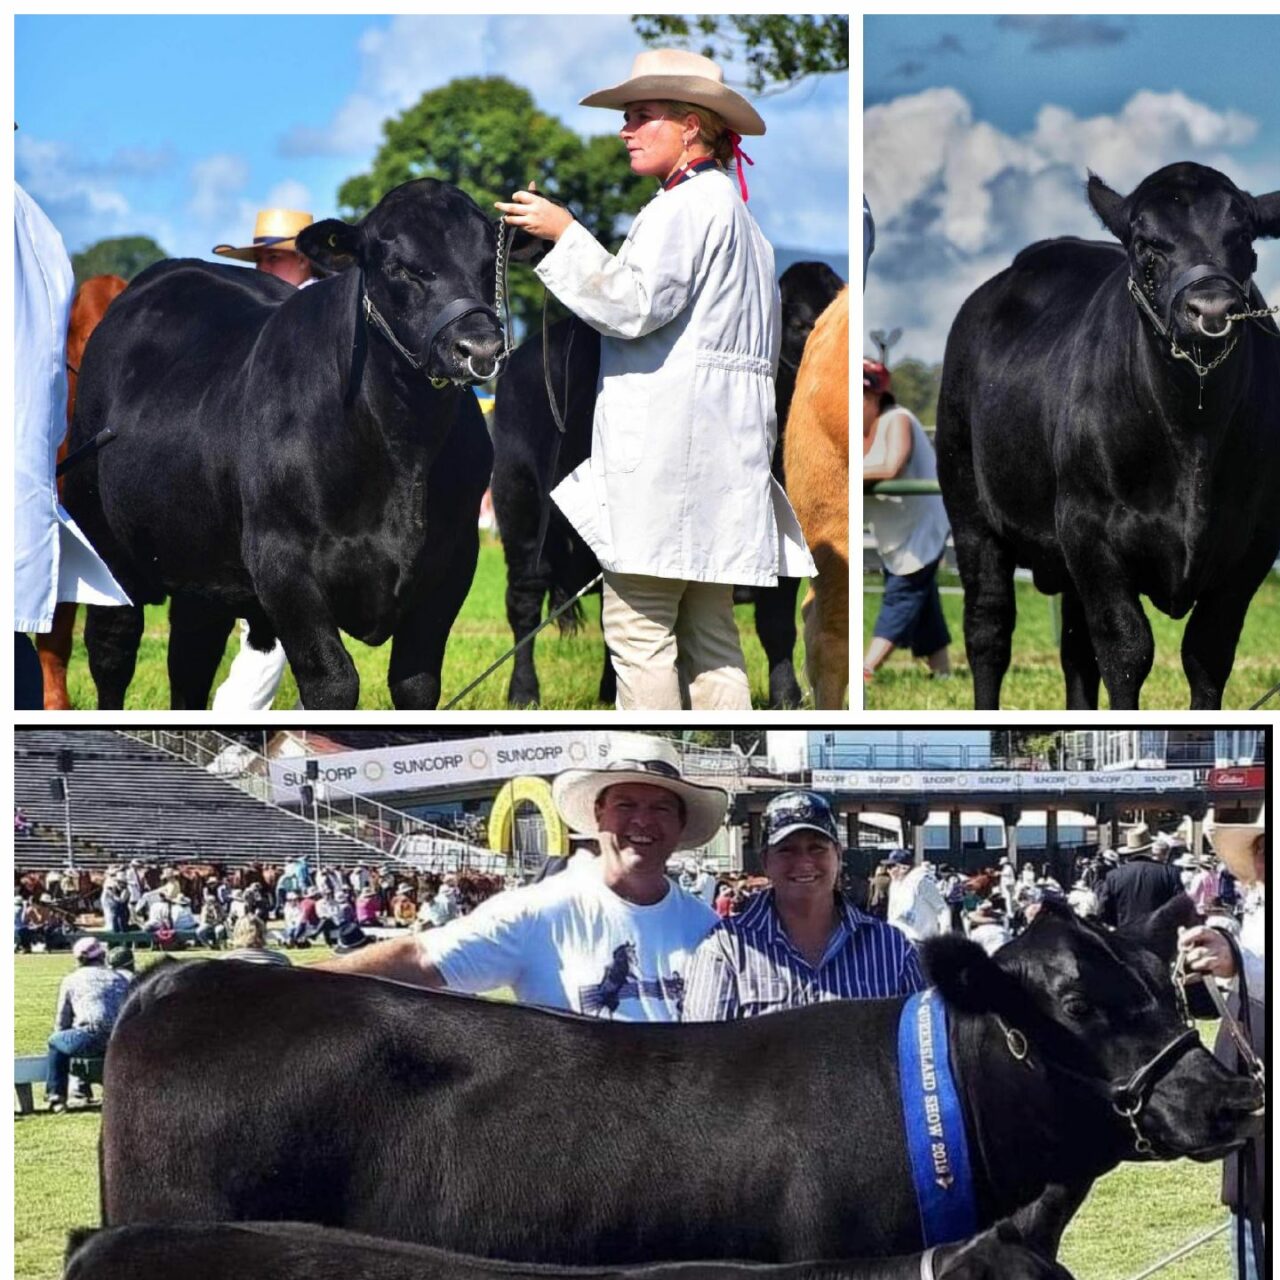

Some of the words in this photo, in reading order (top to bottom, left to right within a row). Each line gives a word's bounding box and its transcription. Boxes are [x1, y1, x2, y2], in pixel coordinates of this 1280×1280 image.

[393, 754, 464, 775] SUNCORP
[497, 745, 564, 764] SUNCORP
[925, 1095, 943, 1138] SHOW
